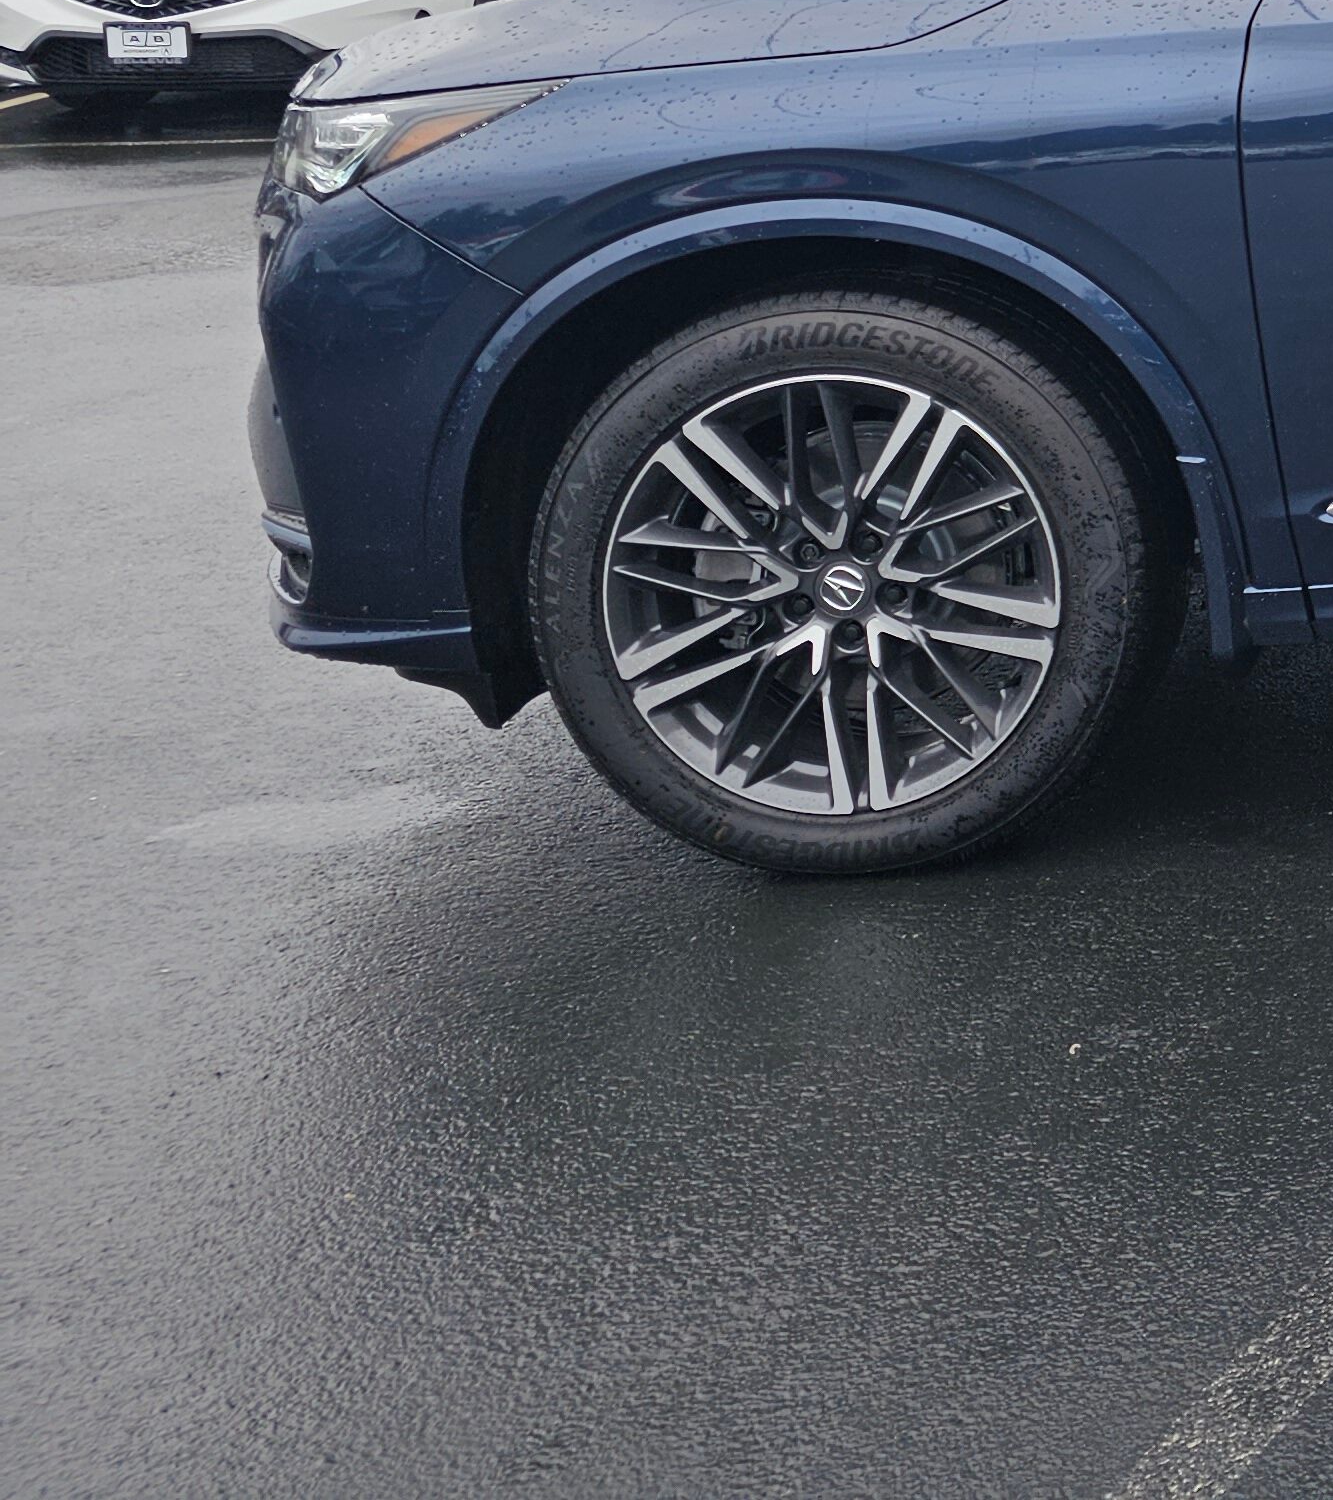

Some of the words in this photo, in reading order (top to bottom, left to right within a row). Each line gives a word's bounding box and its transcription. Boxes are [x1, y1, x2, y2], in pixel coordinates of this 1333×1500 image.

[113, 57, 183, 65] BELLEVUE
[739, 320, 1001, 394] BRIDGESTONE
[544, 482, 585, 633] ALENZA
